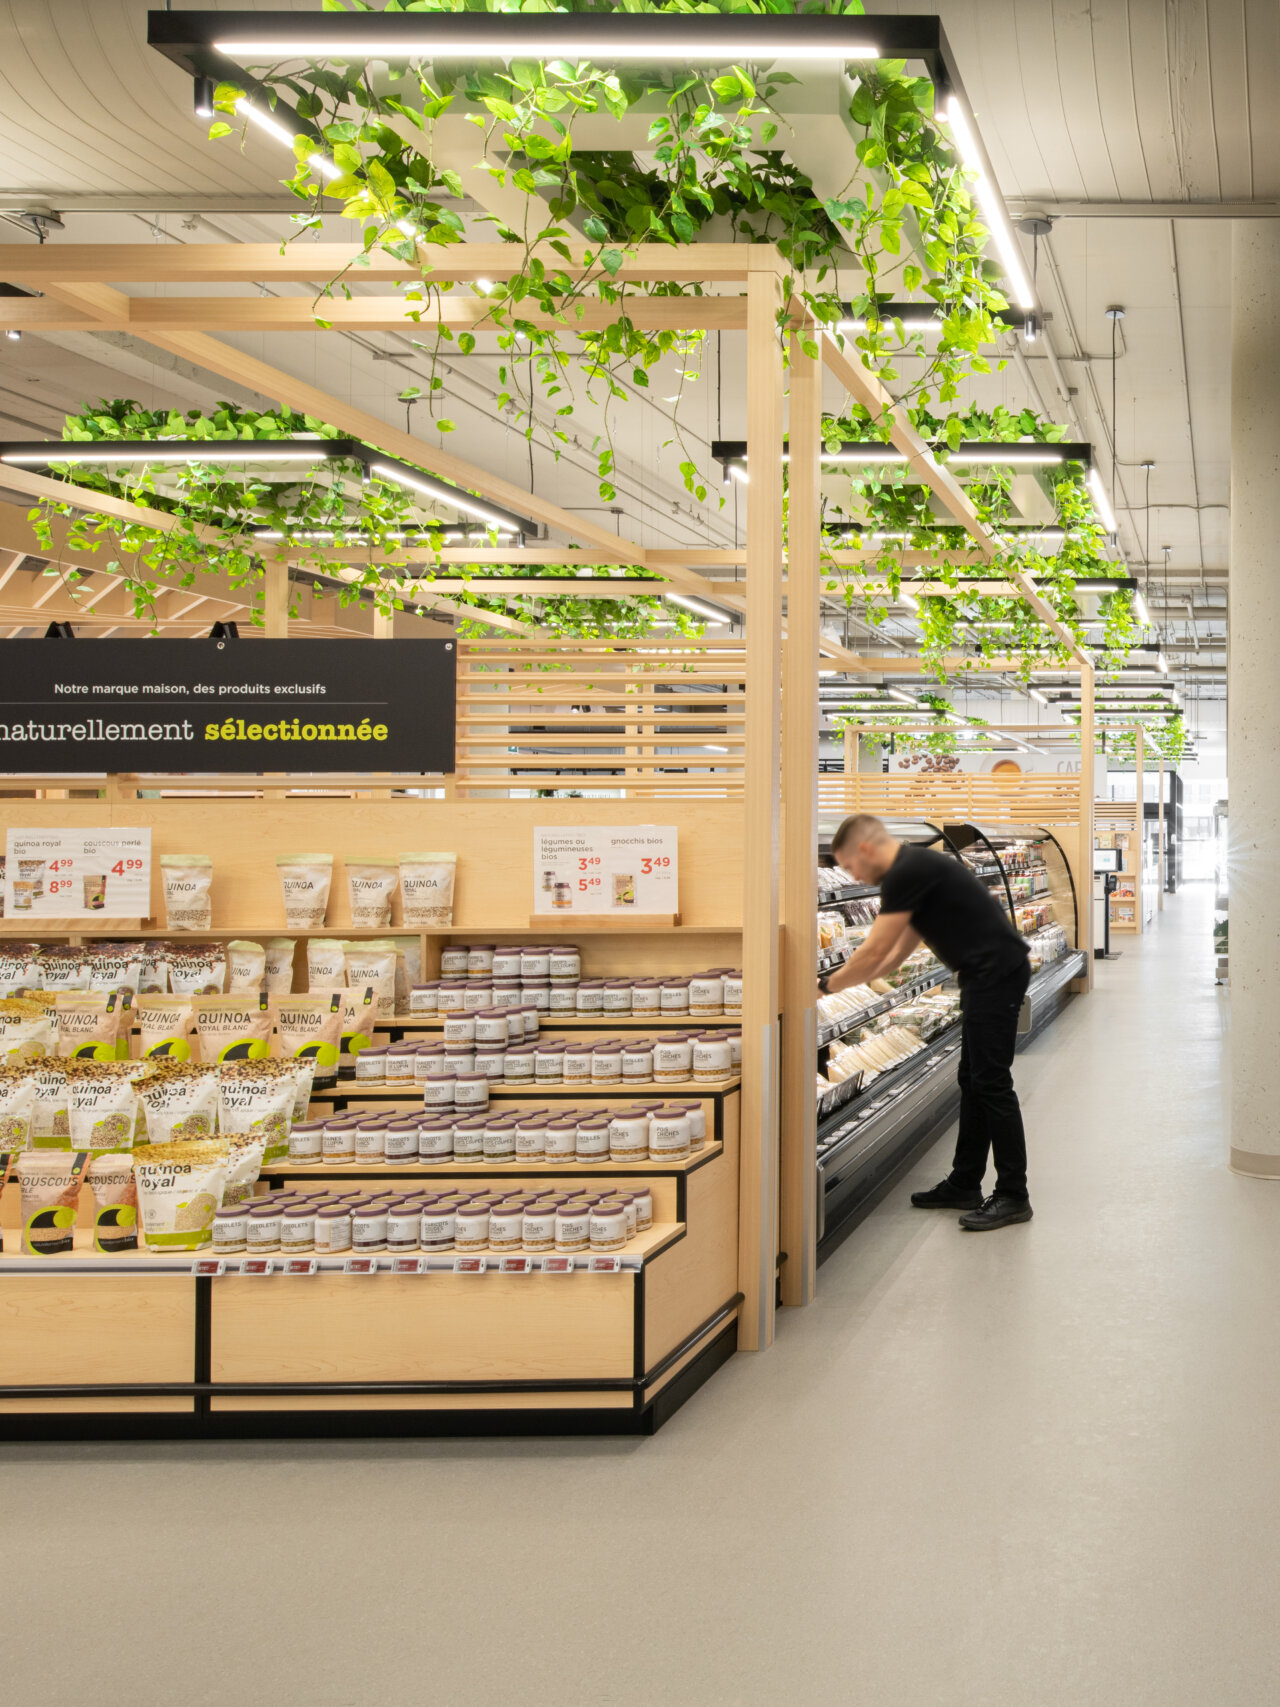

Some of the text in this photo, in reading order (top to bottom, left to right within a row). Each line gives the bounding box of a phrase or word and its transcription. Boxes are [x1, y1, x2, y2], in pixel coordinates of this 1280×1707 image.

[54, 683, 327, 696] Notre marque maison, des produits exclusifs
[0, 717, 389, 741] naturellement sélectionnée
[13, 839, 62, 848] quinoa royal
[121, 838, 142, 848] perlé
[541, 837, 574, 846] légumes
[610, 836, 664, 846] gnocchis bios
[541, 845, 594, 854] légumineuses
[541, 852, 558, 860] bios
[198, 1012, 252, 1025] QUINOA
[280, 1013, 323, 1025] QUINOA
[222, 1024, 249, 1032] BLANC
[140, 1163, 192, 1178] quinoa
